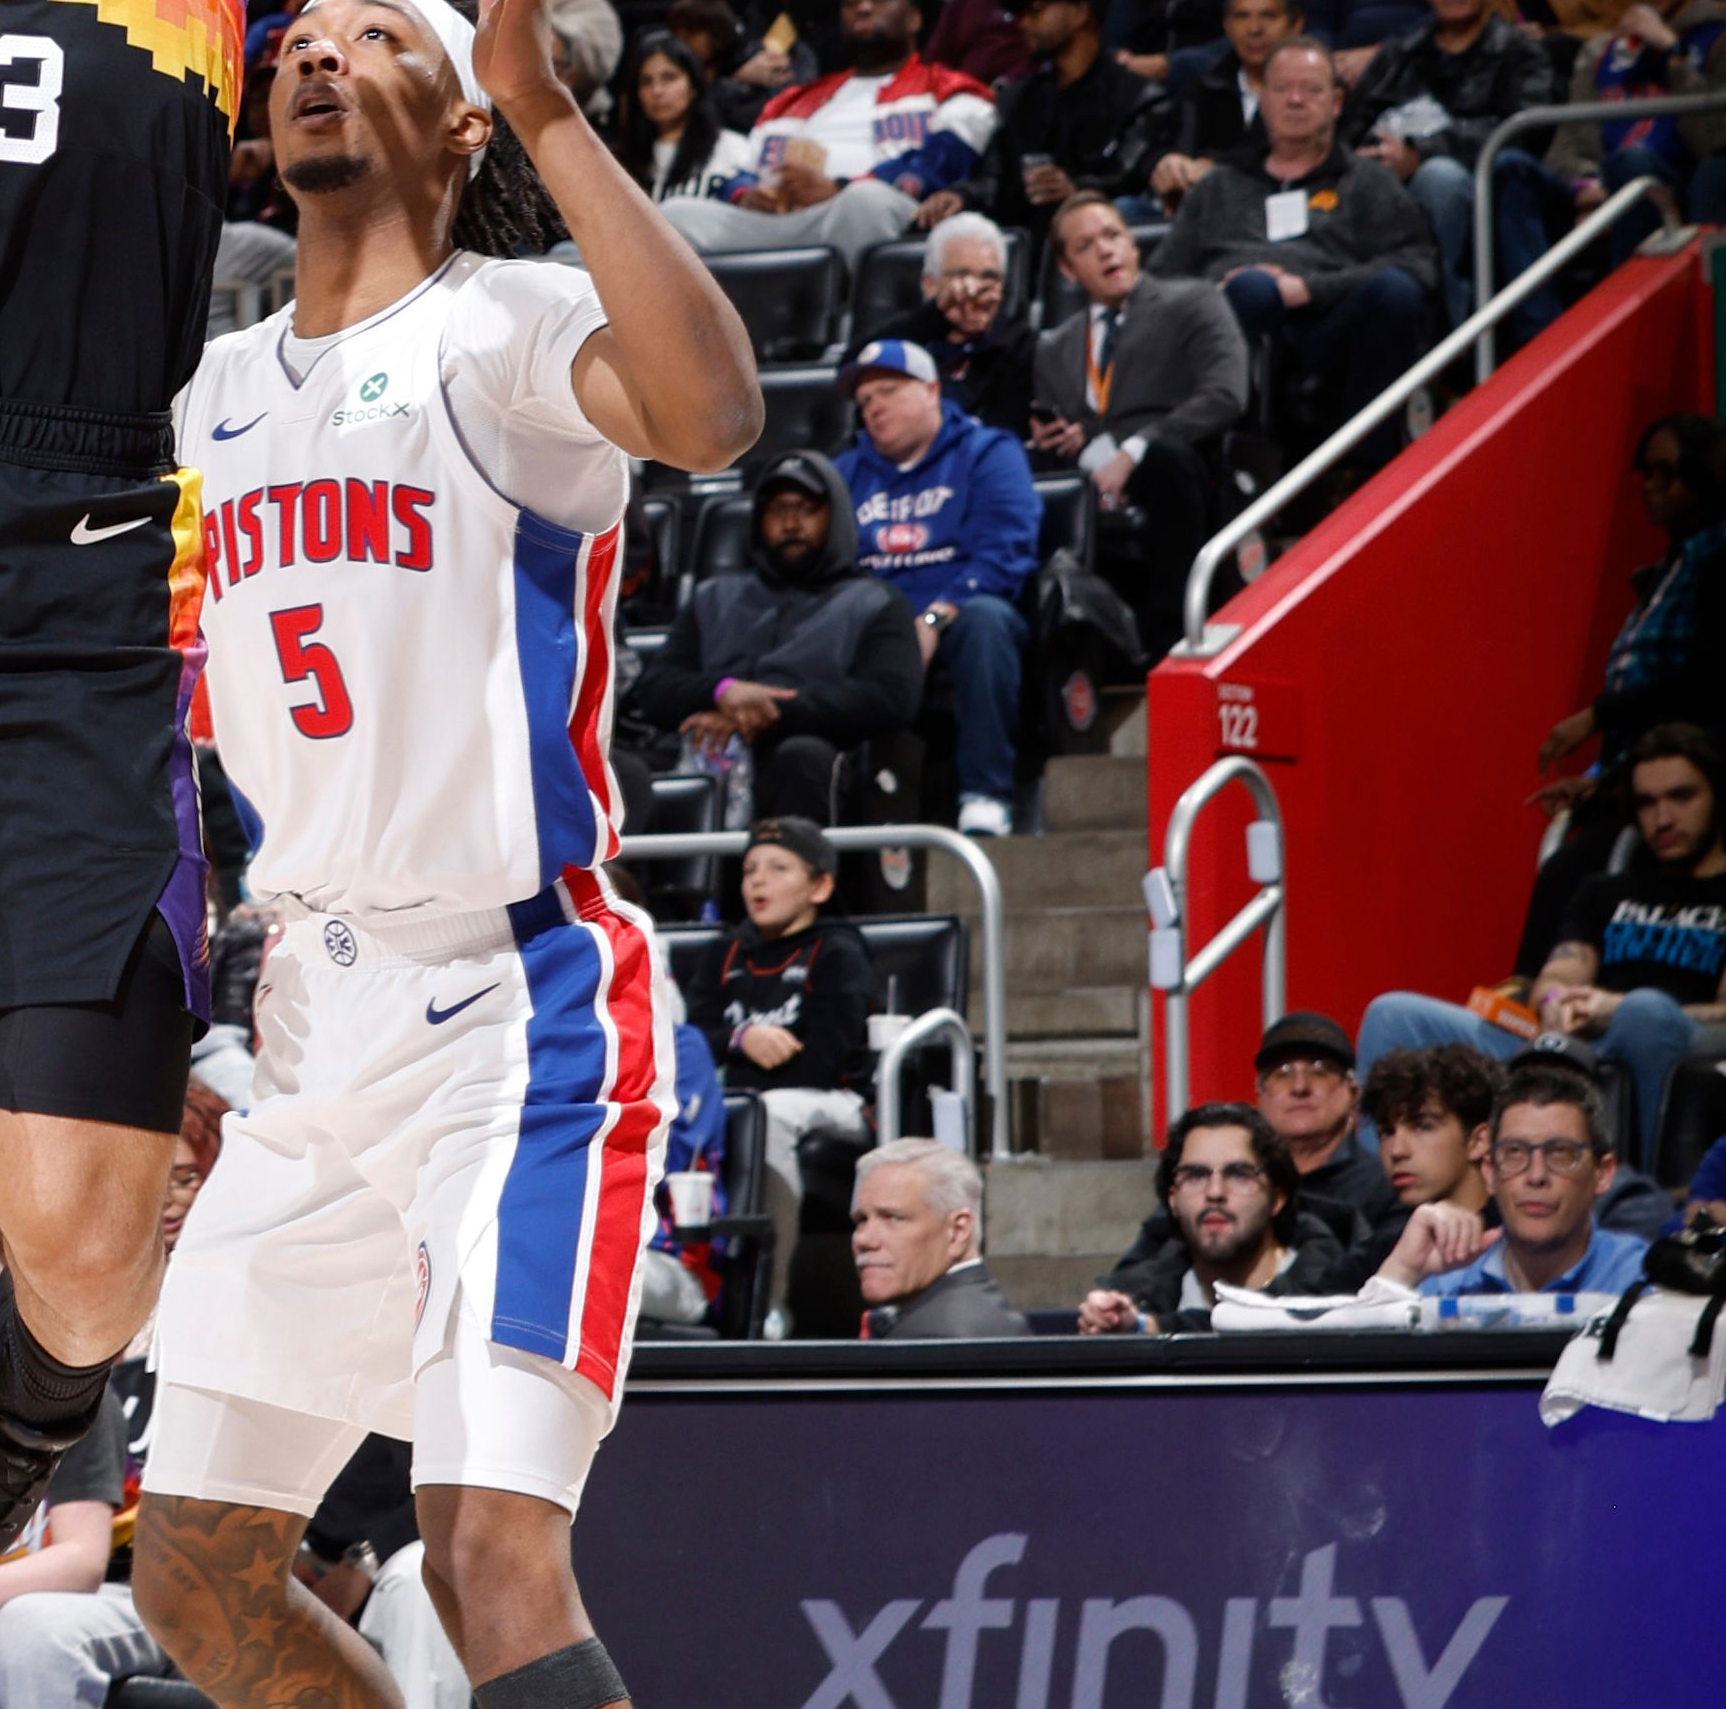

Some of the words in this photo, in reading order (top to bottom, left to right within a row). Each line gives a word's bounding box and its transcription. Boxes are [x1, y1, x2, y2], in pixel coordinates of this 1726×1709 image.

[269, 603, 353, 739] 5
[1218, 703, 1258, 748] 122
[799, 1533, 1511, 1709] xfinity
